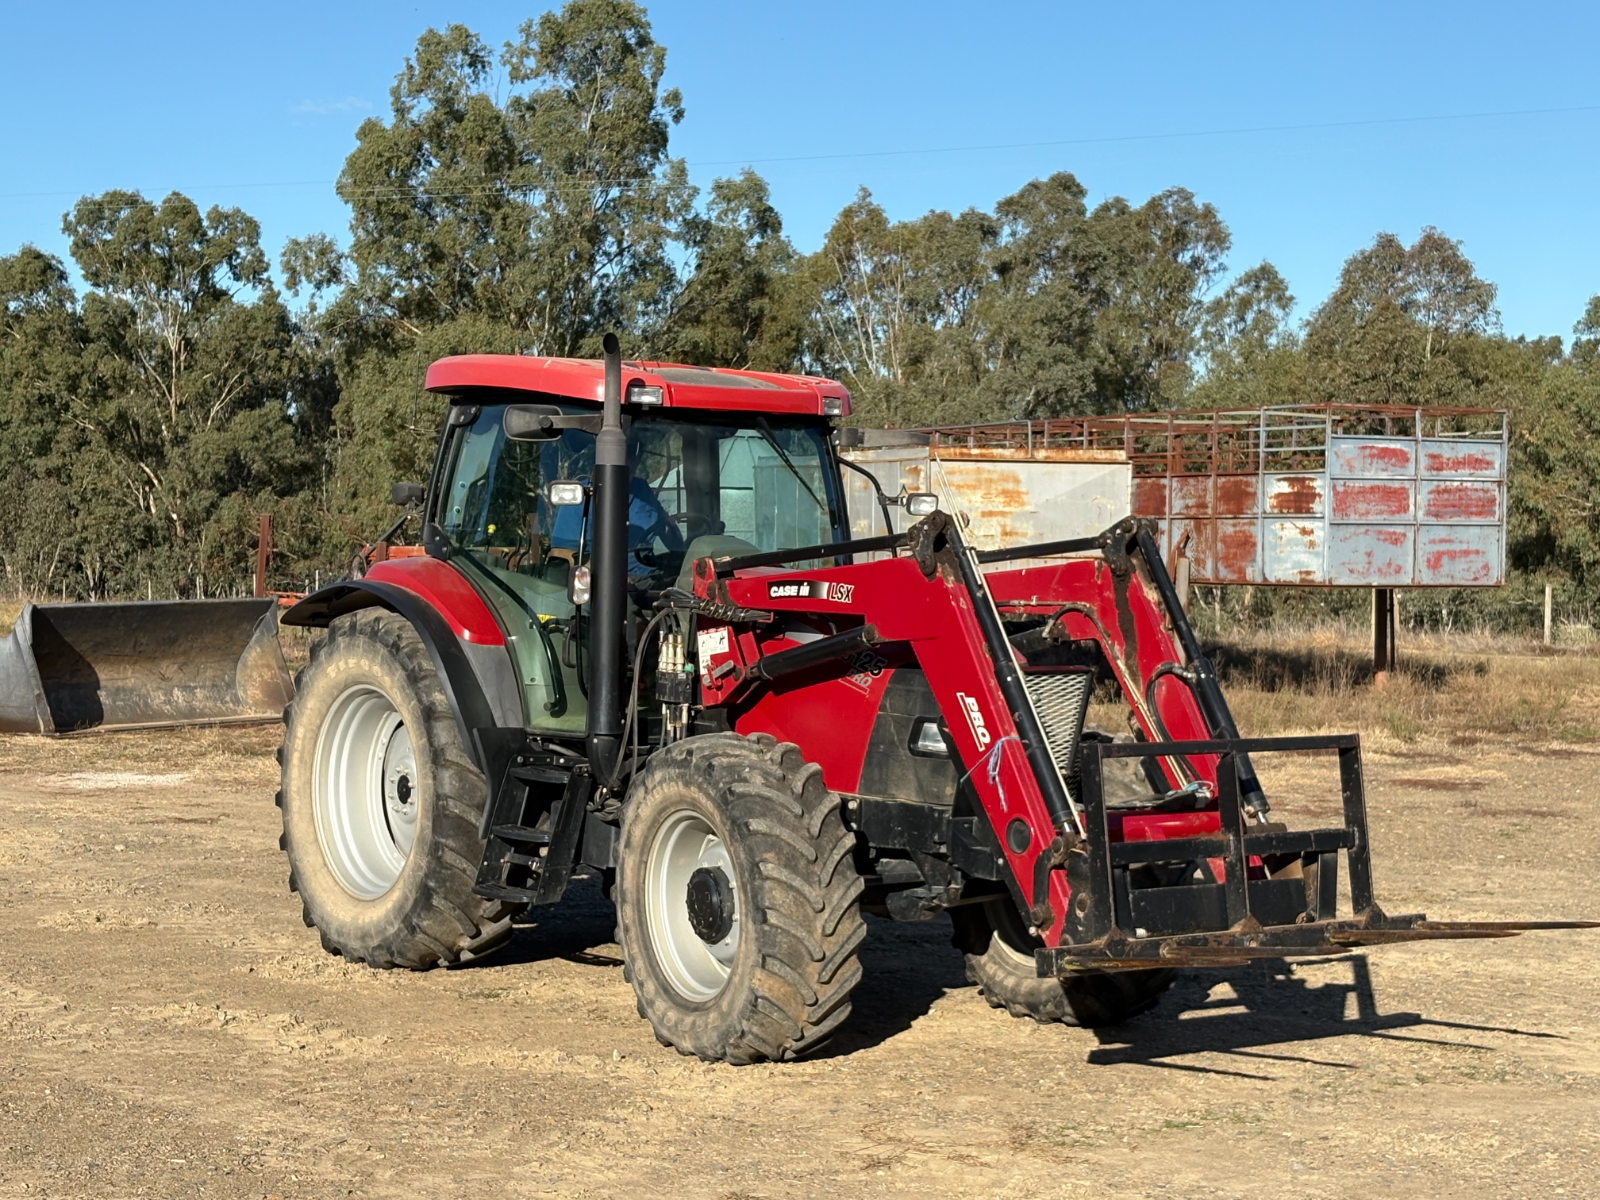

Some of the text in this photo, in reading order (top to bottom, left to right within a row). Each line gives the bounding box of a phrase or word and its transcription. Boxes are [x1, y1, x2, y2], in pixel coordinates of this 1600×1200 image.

[770, 585, 799, 597] CASE
[829, 582, 855, 603] LSX
[964, 696, 991, 744] PRO
